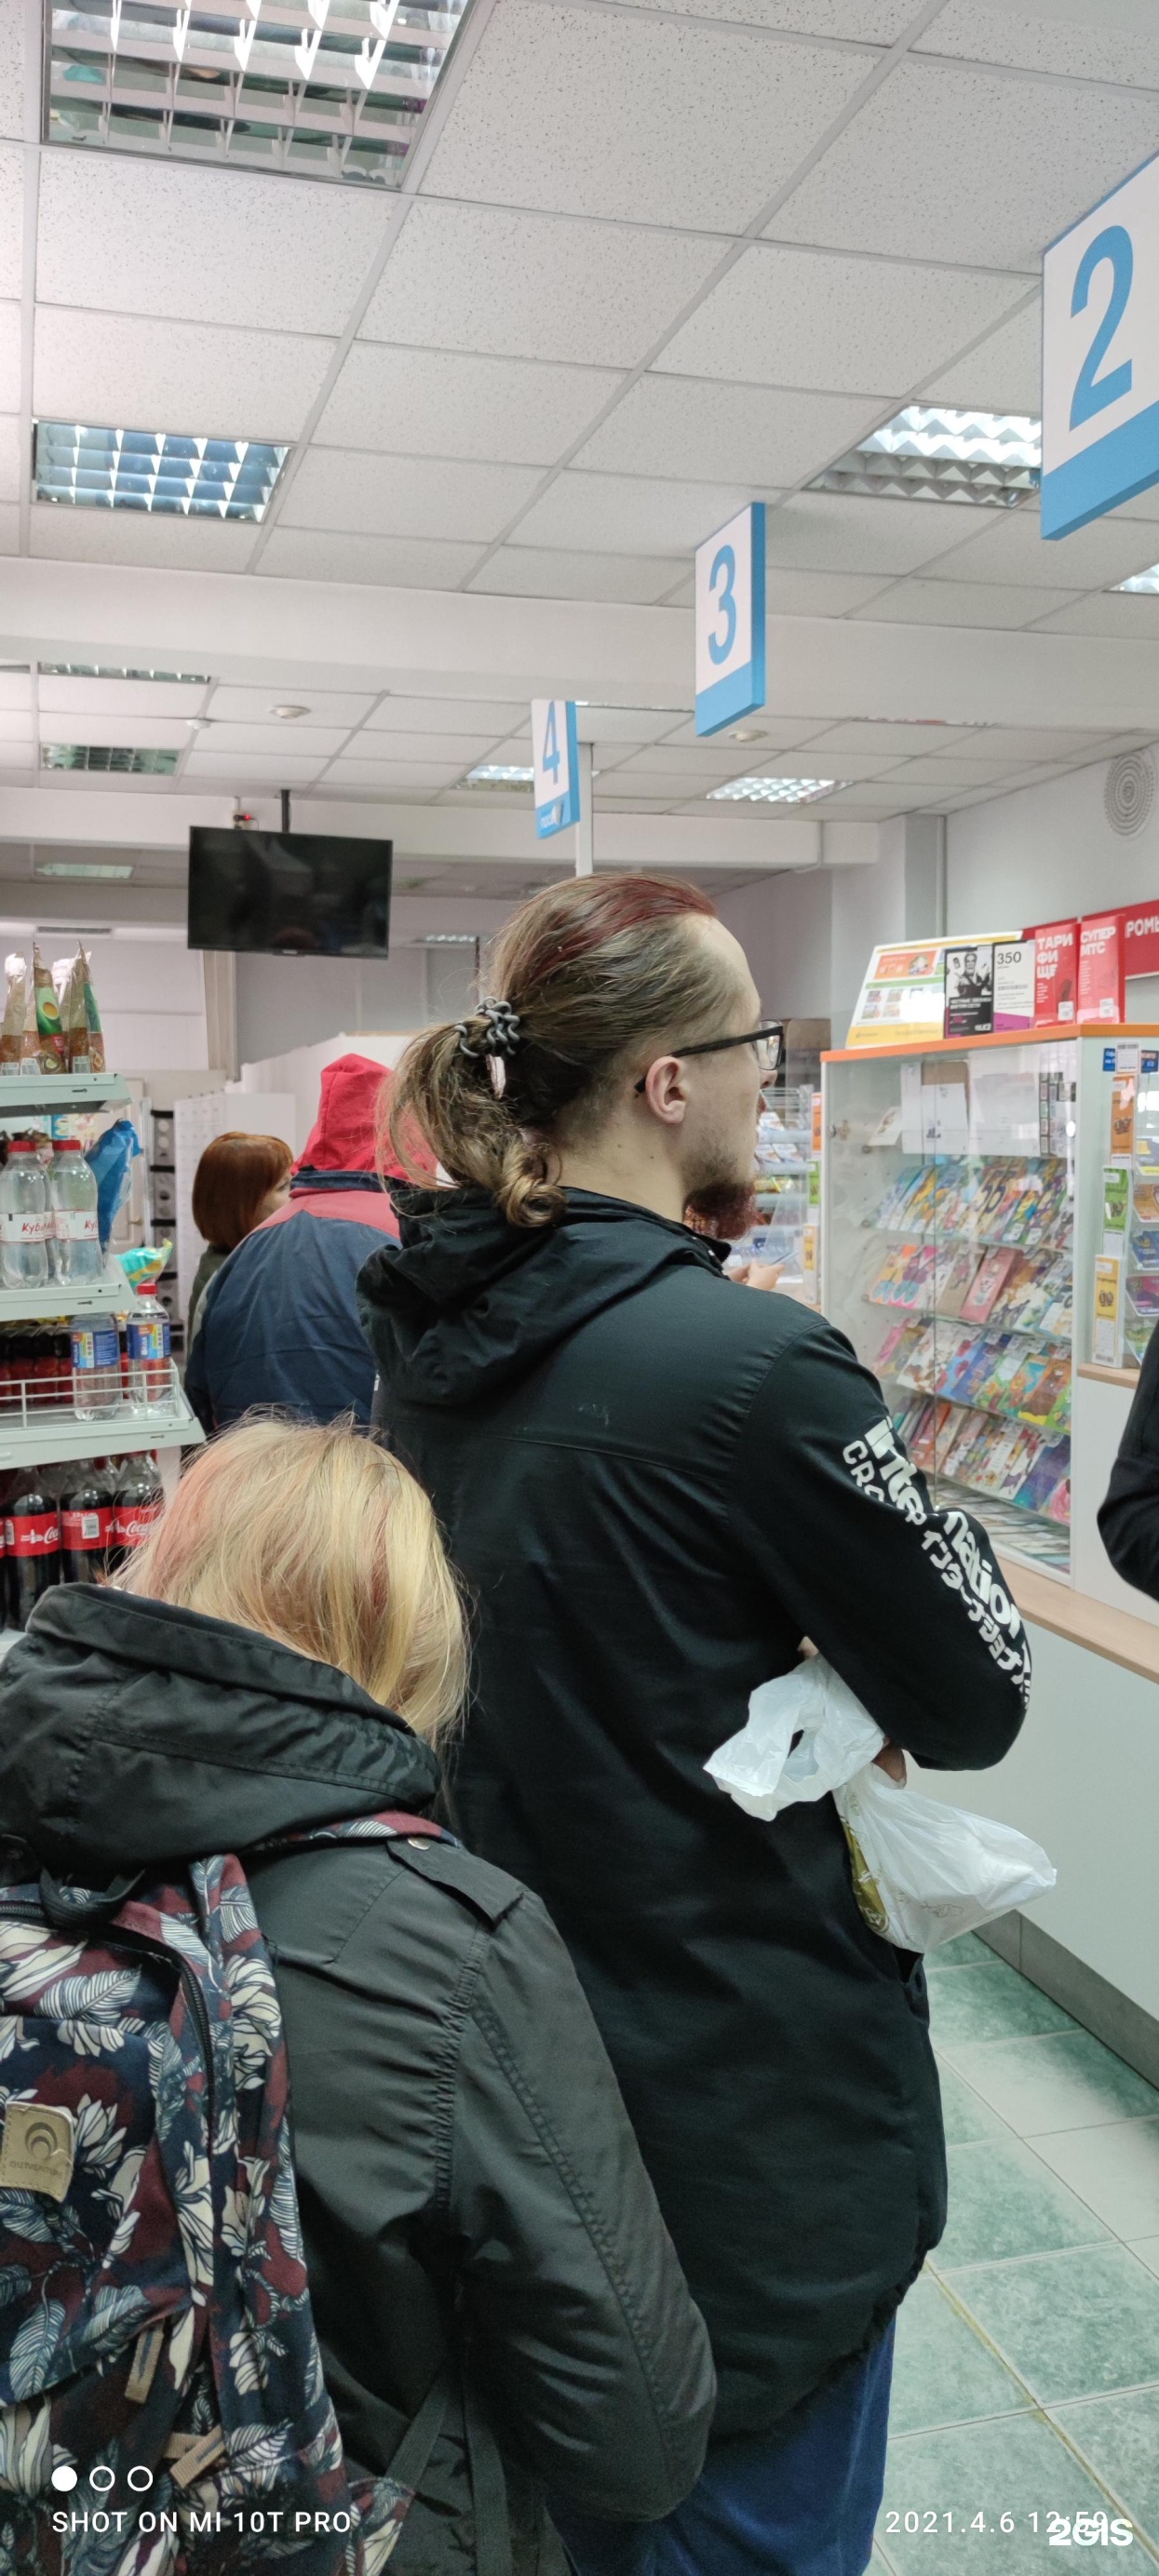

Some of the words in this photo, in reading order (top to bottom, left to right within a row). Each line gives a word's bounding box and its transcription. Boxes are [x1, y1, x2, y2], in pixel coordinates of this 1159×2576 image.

[1070, 225, 1134, 432] 2
[708, 544, 736, 665] 3
[543, 701, 561, 786] 4
[1037, 932, 1073, 950] ТАРИ
[1080, 926, 1116, 944] СУПЕР
[997, 951, 1022, 965] 350
[1036, 950, 1058, 965] ФИ
[1080, 941, 1106, 957] МТС
[1036, 963, 1058, 980] ЩЕ
